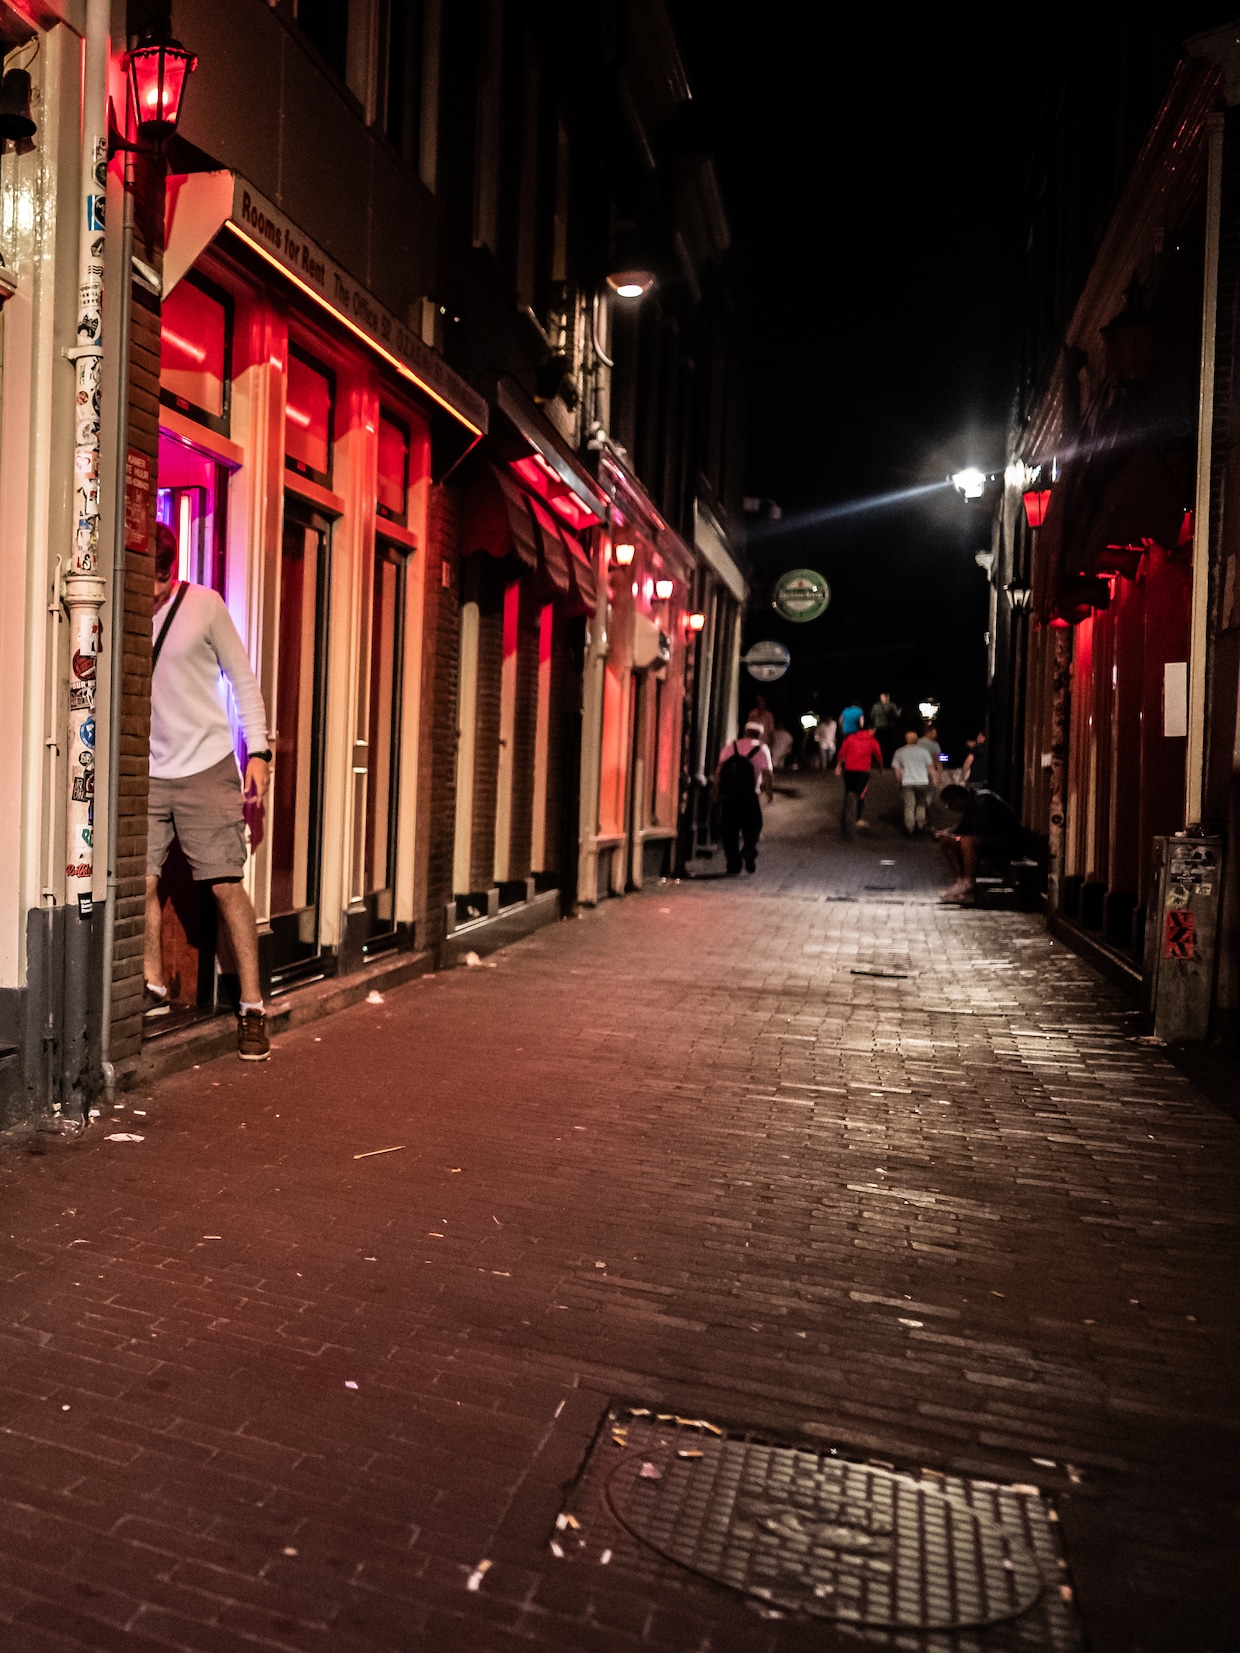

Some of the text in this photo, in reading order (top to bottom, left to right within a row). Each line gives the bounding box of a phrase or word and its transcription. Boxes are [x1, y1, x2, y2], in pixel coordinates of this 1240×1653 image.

[242, 190, 282, 247] Rooms
[284, 228, 300, 260] for
[301, 249, 325, 287] Rent
[334, 272, 350, 309] The
